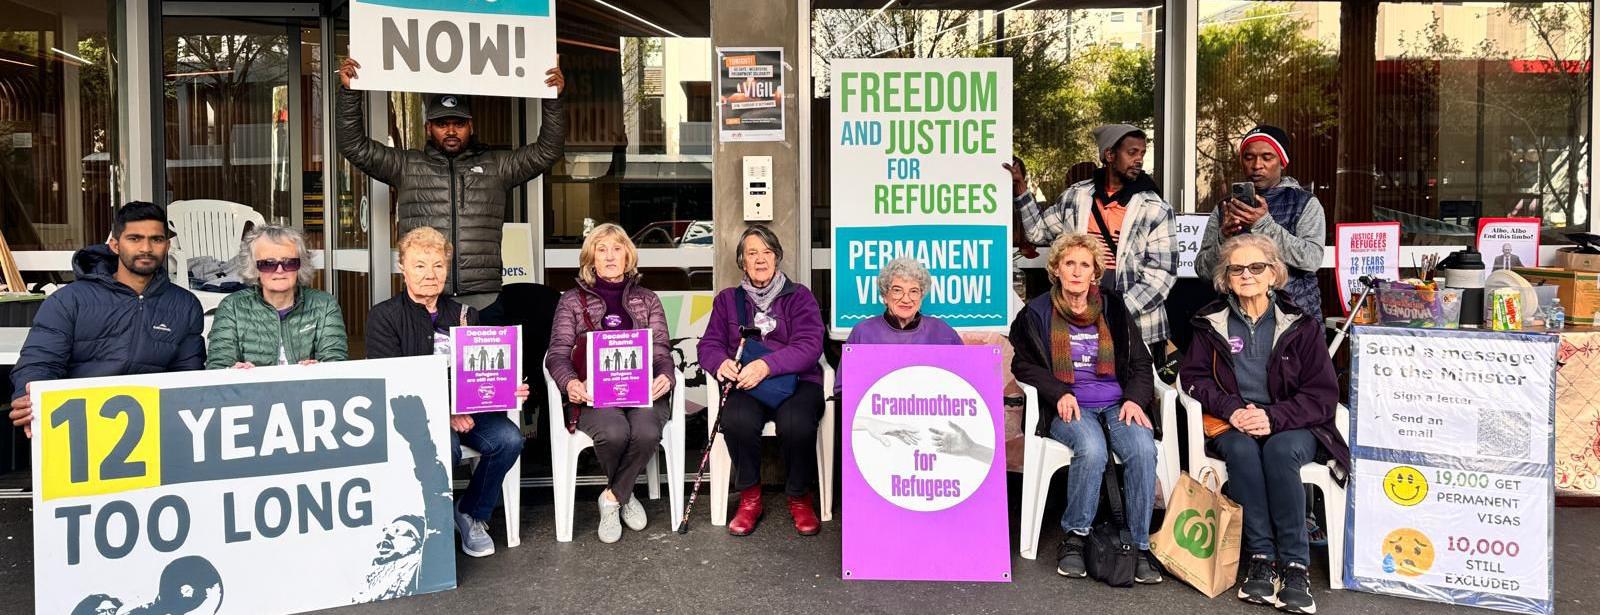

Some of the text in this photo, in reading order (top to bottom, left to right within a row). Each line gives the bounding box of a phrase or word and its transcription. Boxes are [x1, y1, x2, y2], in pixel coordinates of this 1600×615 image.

[382, 17, 525, 78] NOW!
[743, 82, 775, 98] VIGIL
[841, 71, 998, 113] FREEDOM
[841, 119, 997, 154] AND JUSTICE
[888, 158, 920, 180] FOR
[874, 183, 997, 215] REFUGEES
[1351, 232, 1387, 241] JUSTICE FOR
[1351, 240, 1387, 249] REFUGEES
[849, 239, 994, 270] PERMANENT
[1351, 255, 1385, 266] 12 YEARS
[1350, 265, 1385, 275] OF LIMBO
[930, 274, 992, 304] NOW!
[1366, 342, 1415, 358] Send
[1441, 347, 1535, 366] message
[1373, 363, 1527, 386] to the Minister
[871, 392, 977, 417] Grandmothers
[1393, 391, 1473, 406] Sign a letter
[1391, 413, 1444, 426] Send an
[51, 394, 376, 484] 12 YEARS
[1398, 427, 1434, 439] email
[914, 449, 937, 472] for
[891, 474, 961, 502] Refugees
[1435, 470, 1522, 491] 19,000 GET
[1436, 492, 1521, 509] PERMANENT
[55, 477, 373, 566] TOO LONG
[1477, 512, 1521, 527] VISAS
[1447, 535, 1520, 558] 10,000
[1466, 559, 1505, 574] STILL
[1445, 572, 1521, 592] EXCLUDED
